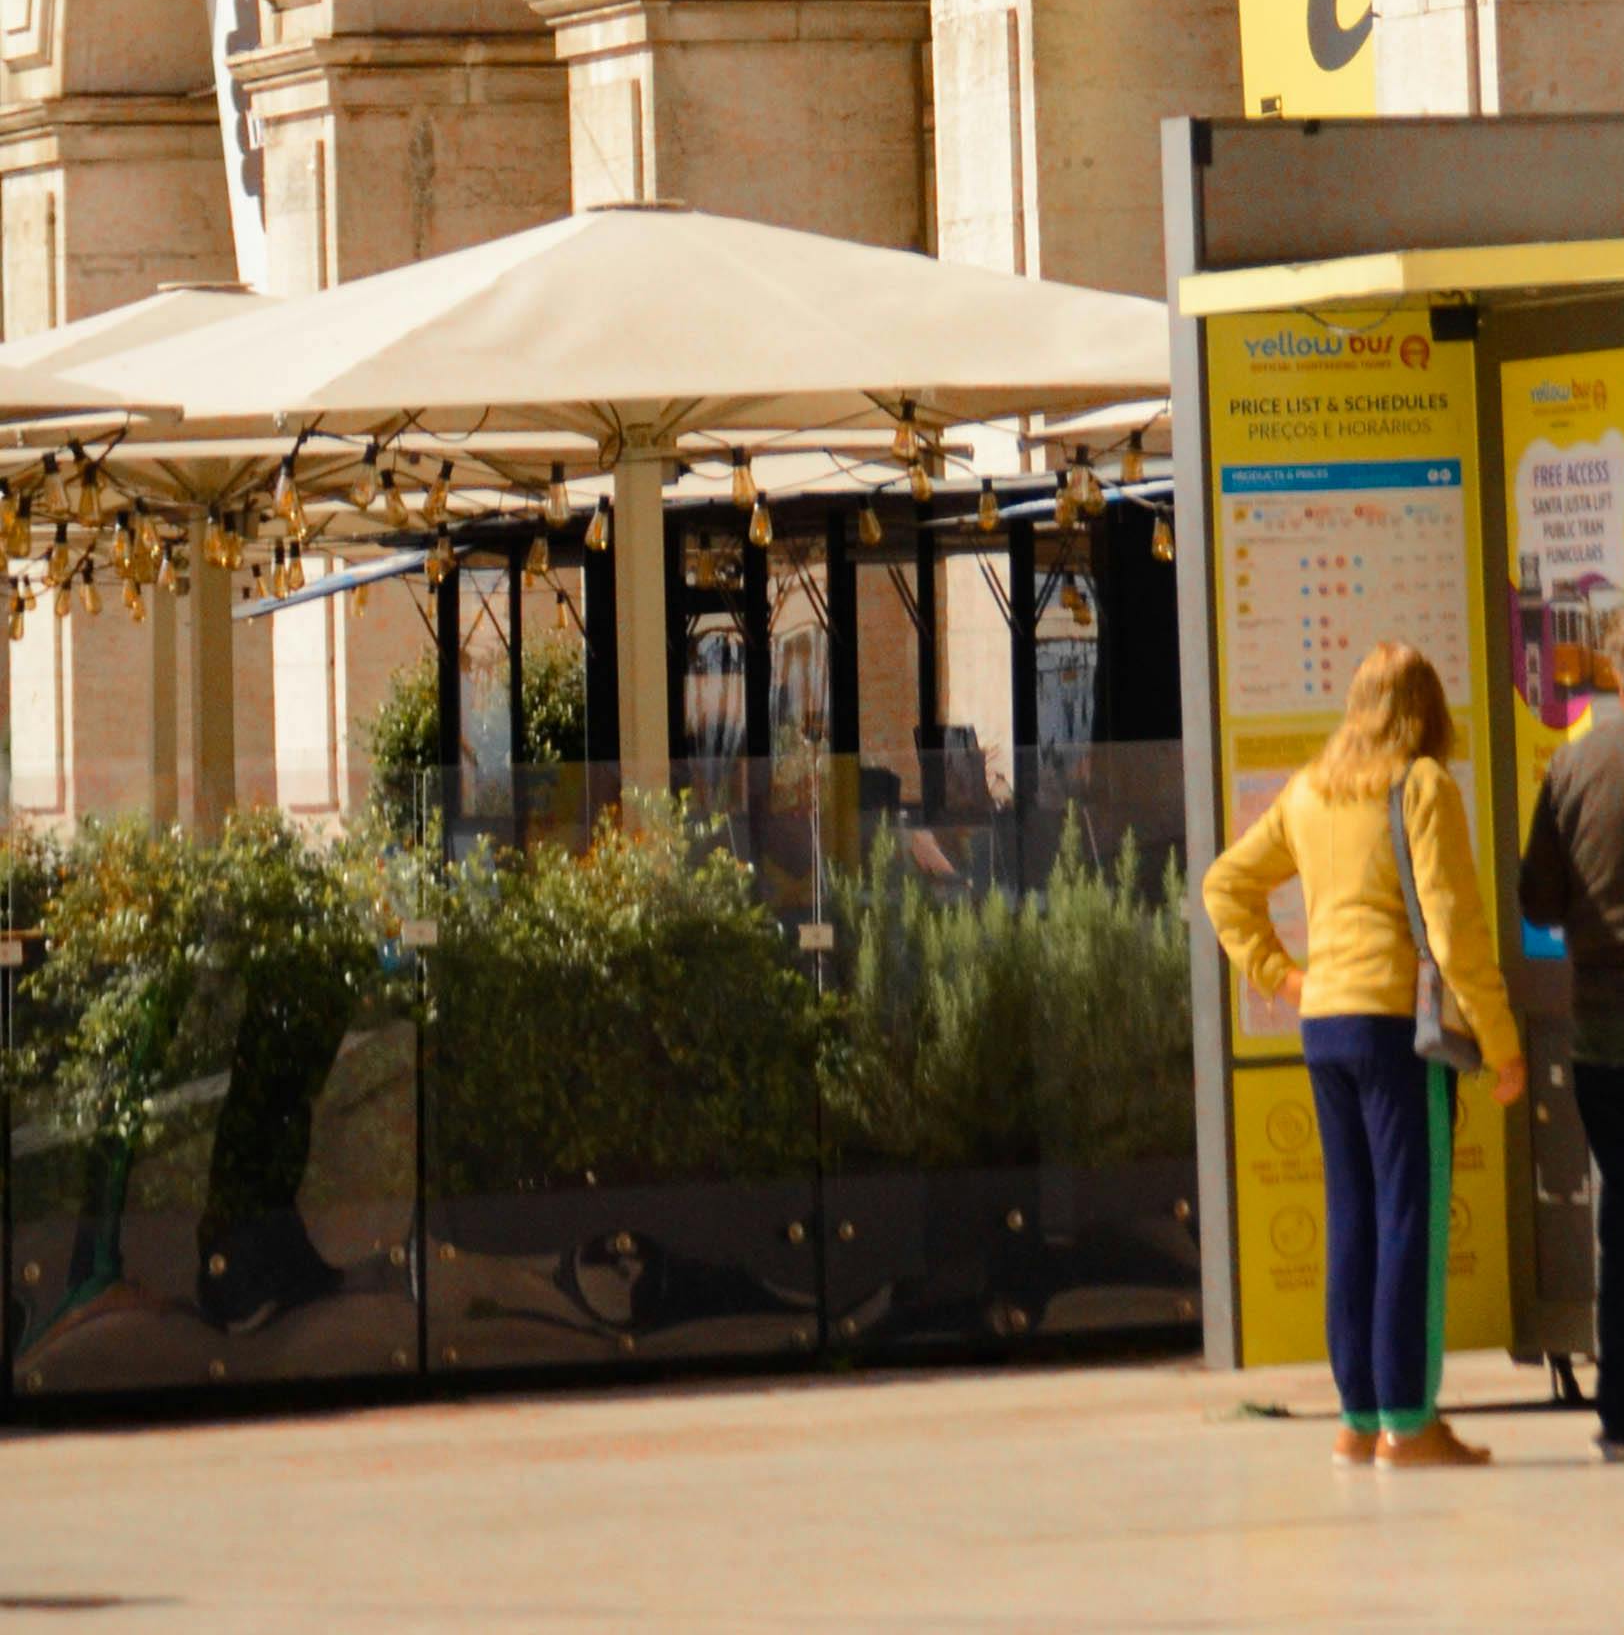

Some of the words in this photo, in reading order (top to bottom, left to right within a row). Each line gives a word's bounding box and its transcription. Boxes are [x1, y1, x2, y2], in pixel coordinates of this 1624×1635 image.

[1244, 330, 1344, 358] yellow
[1229, 399, 1280, 416] PRICE
[1286, 397, 1322, 415] LIST
[1326, 397, 1339, 413] &
[1344, 393, 1449, 412] SCHEDULES
[1248, 421, 1318, 442] PREÇOS
[1324, 422, 1334, 437] E
[1533, 463, 1563, 488] FREE
[1566, 459, 1610, 487] ACCESS
